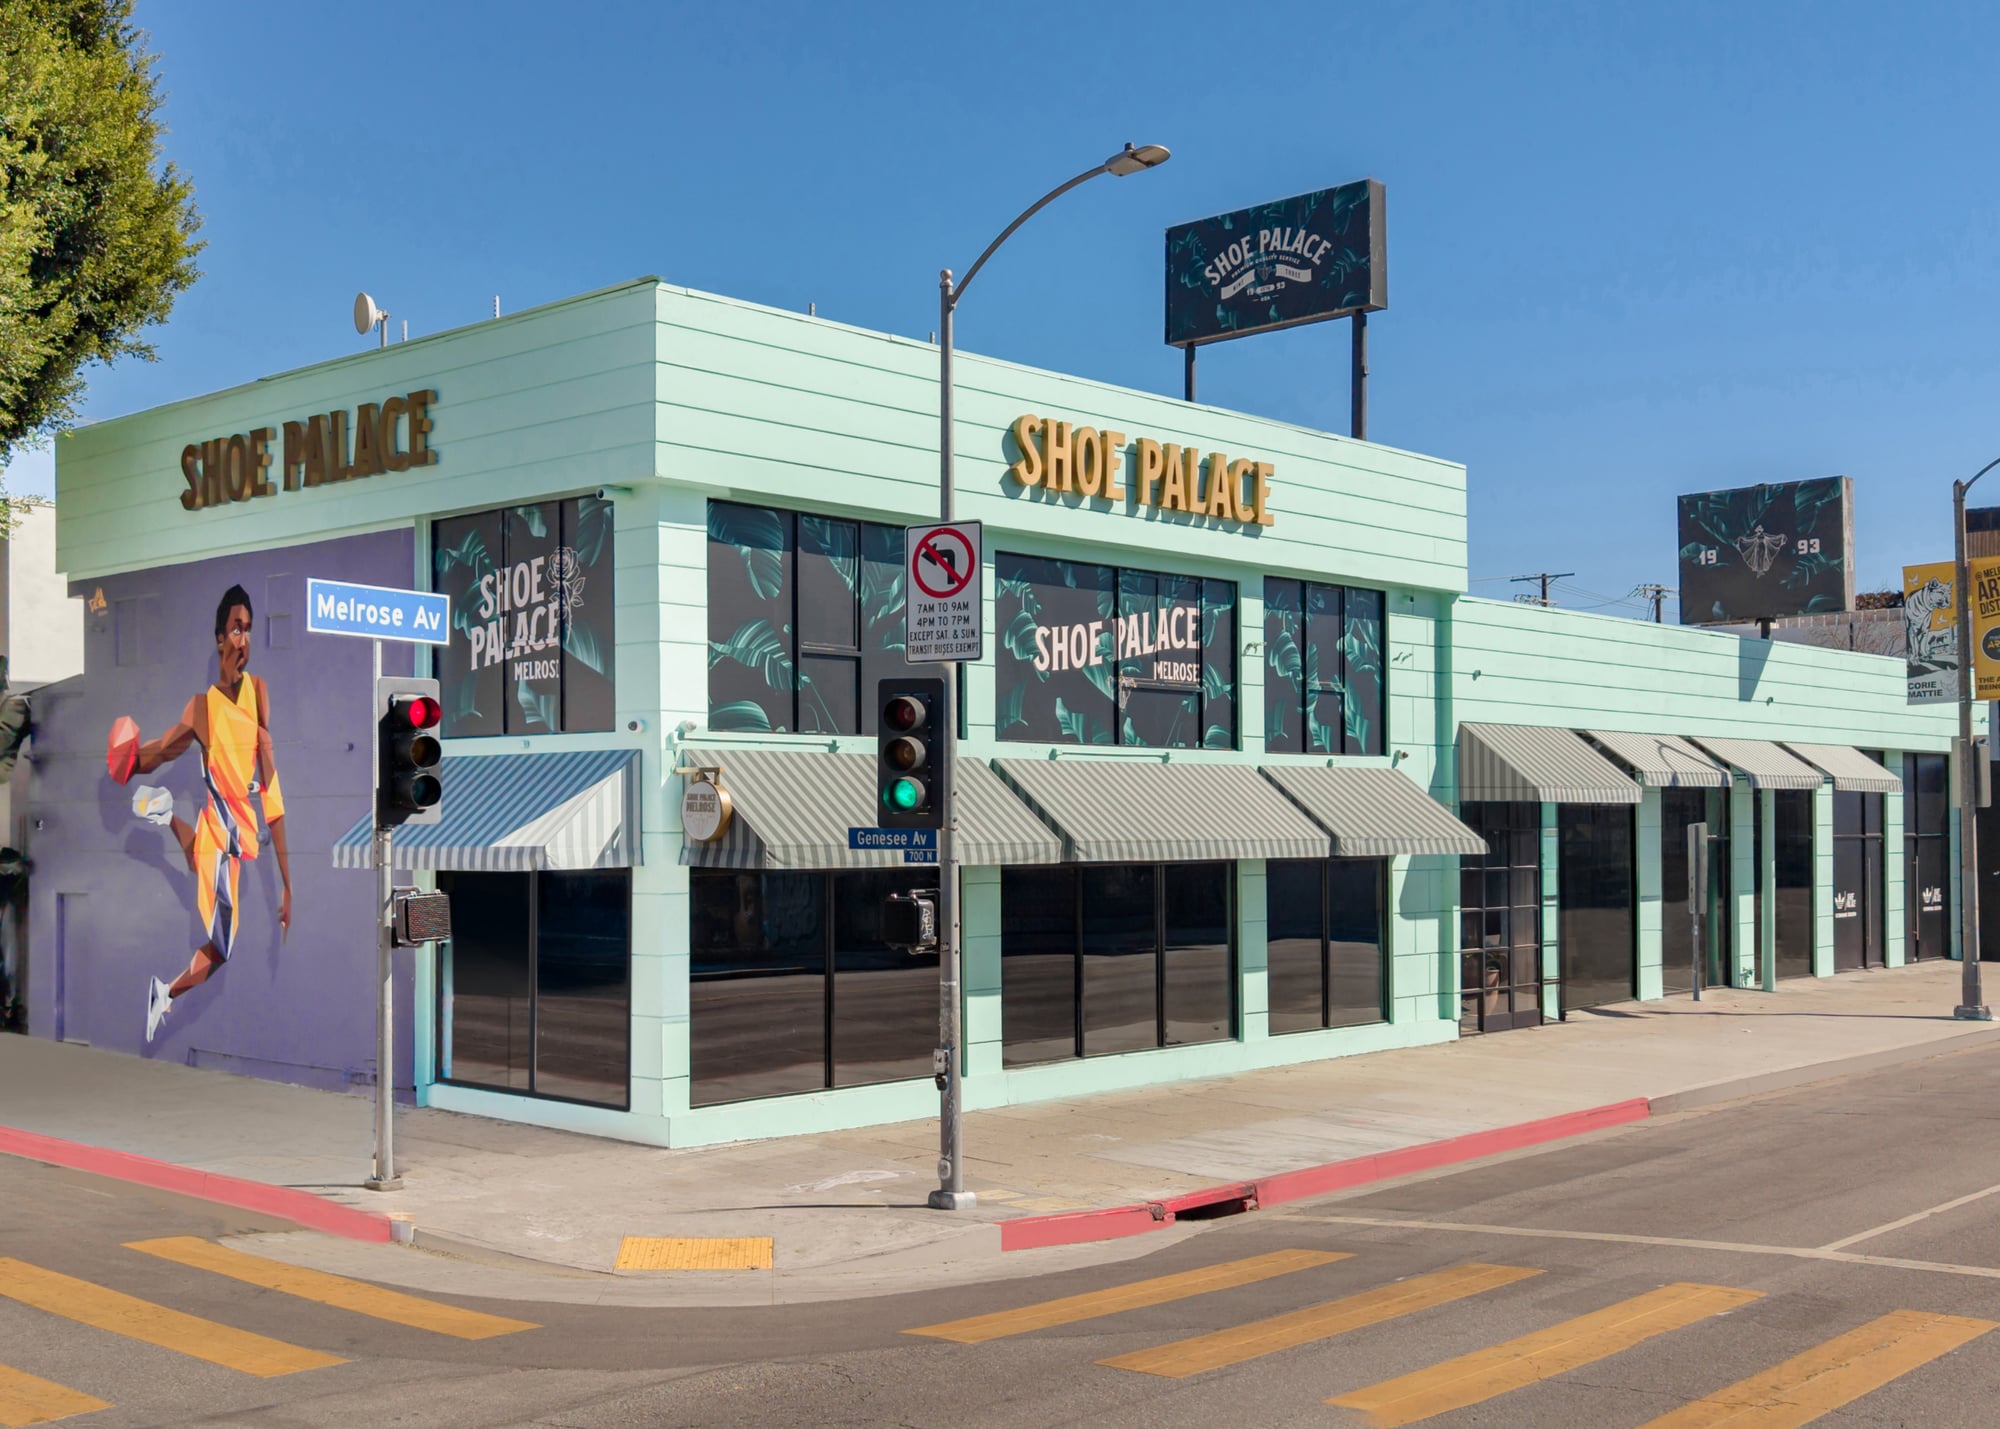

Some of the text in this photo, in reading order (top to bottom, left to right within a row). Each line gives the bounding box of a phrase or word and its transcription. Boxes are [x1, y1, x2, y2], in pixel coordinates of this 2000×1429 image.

[1204, 227, 1332, 285] SHOE PALACE
[180, 389, 438, 511] SHOE PALACE
[1011, 414, 1274, 527] SHOE PALACE
[1699, 538, 1820, 565] 19 93
[317, 593, 441, 631] Melrose Av
[471, 556, 559, 671] SHOE PALACE
[917, 601, 969, 614] 7AM TO 9AM
[917, 614, 970, 627] 4PM TO 7PM
[909, 630, 934, 641] EXCEPT
[952, 629, 959, 640] &
[1033, 607, 1200, 672] SHOE PALACE
[909, 641, 979, 655] TRANSIT BUSES EXEMPT
[1153, 660, 1200, 682] MELROSE
[1908, 681, 1937, 690] CORIE
[1908, 688, 1944, 698] MATTIE
[686, 801, 716, 812] MELROSE
[857, 831, 927, 846] Genesee Av
[909, 851, 933, 861] 700 N
